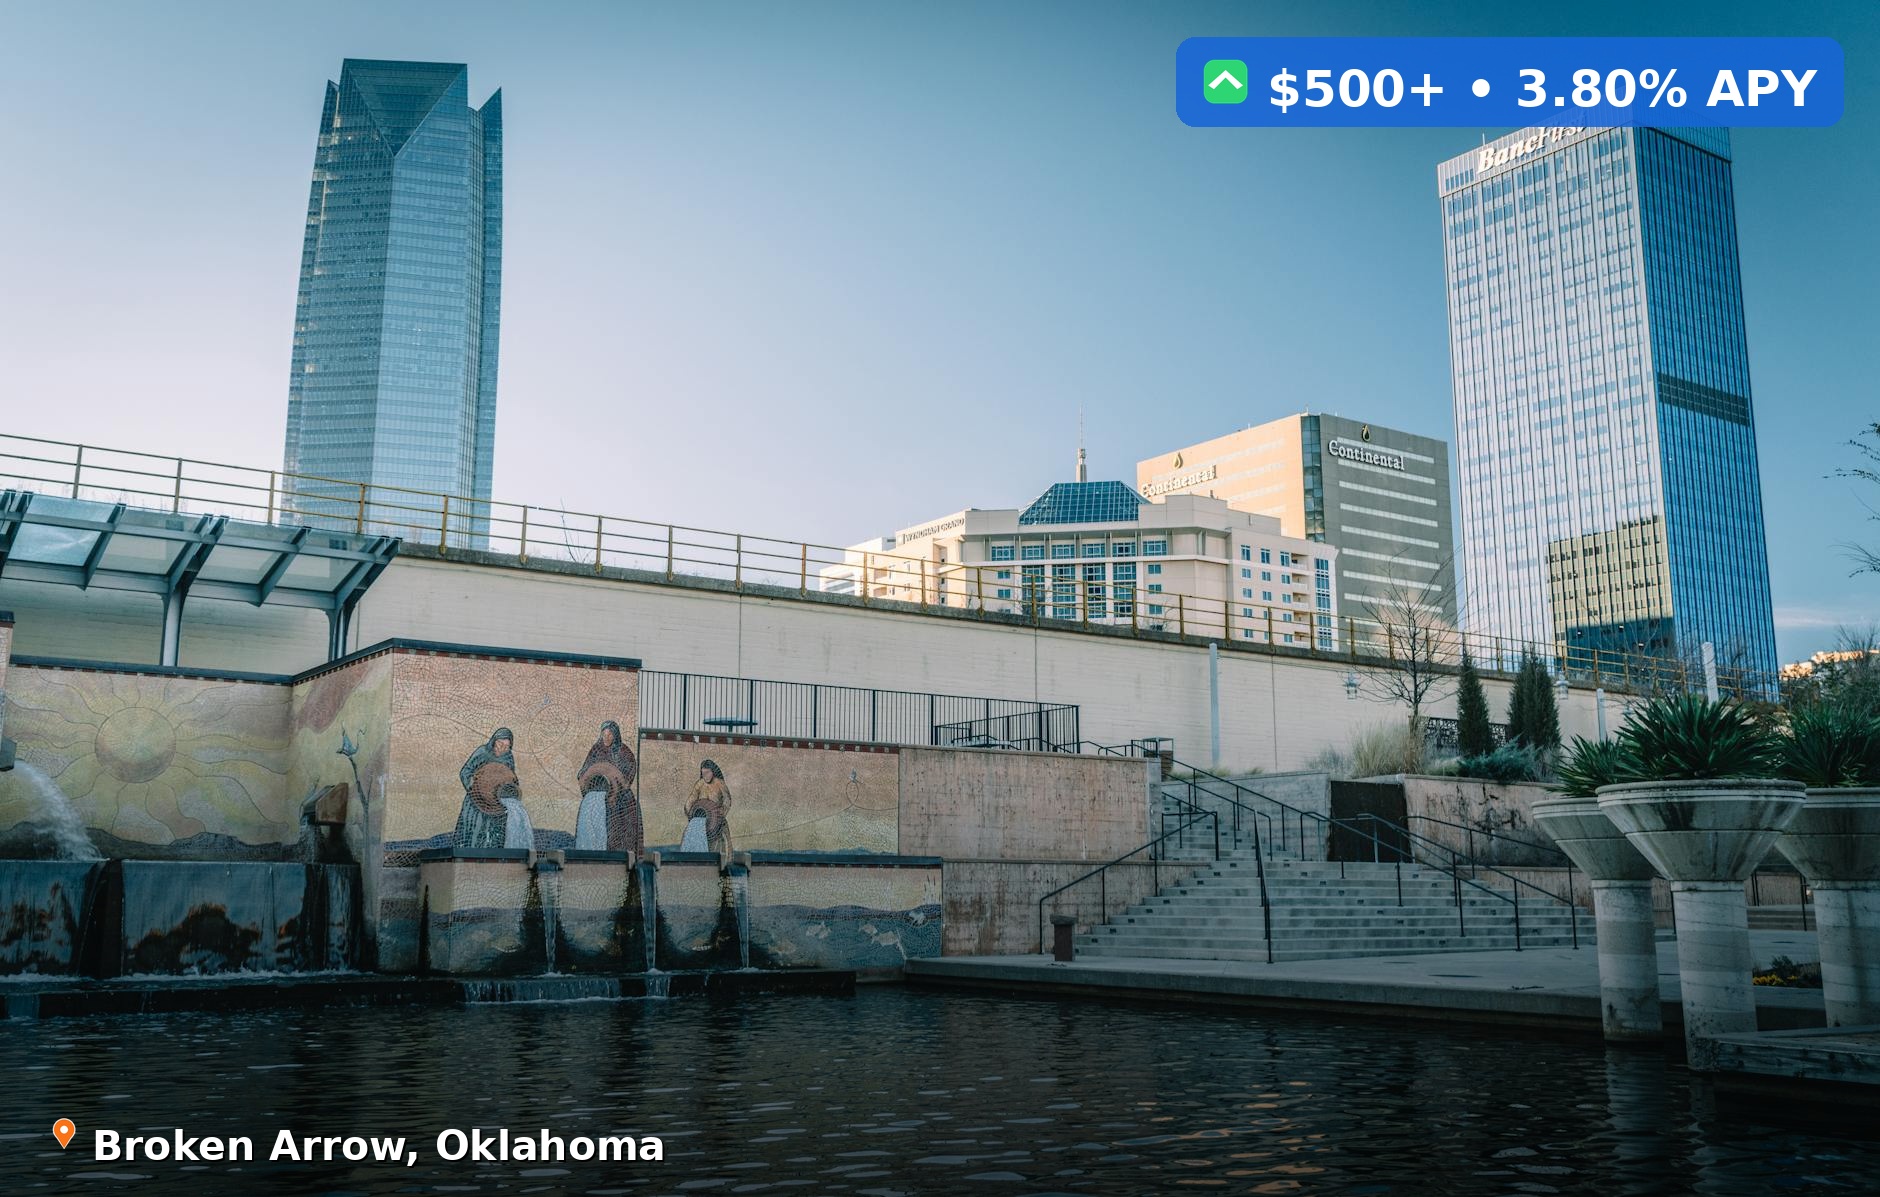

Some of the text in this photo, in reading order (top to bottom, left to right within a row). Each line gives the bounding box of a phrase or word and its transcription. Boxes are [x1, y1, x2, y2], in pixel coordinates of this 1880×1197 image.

[1476, 117, 1586, 173] BancFirs
[1328, 439, 1405, 471] Continental
[1141, 464, 1217, 498] Continental
